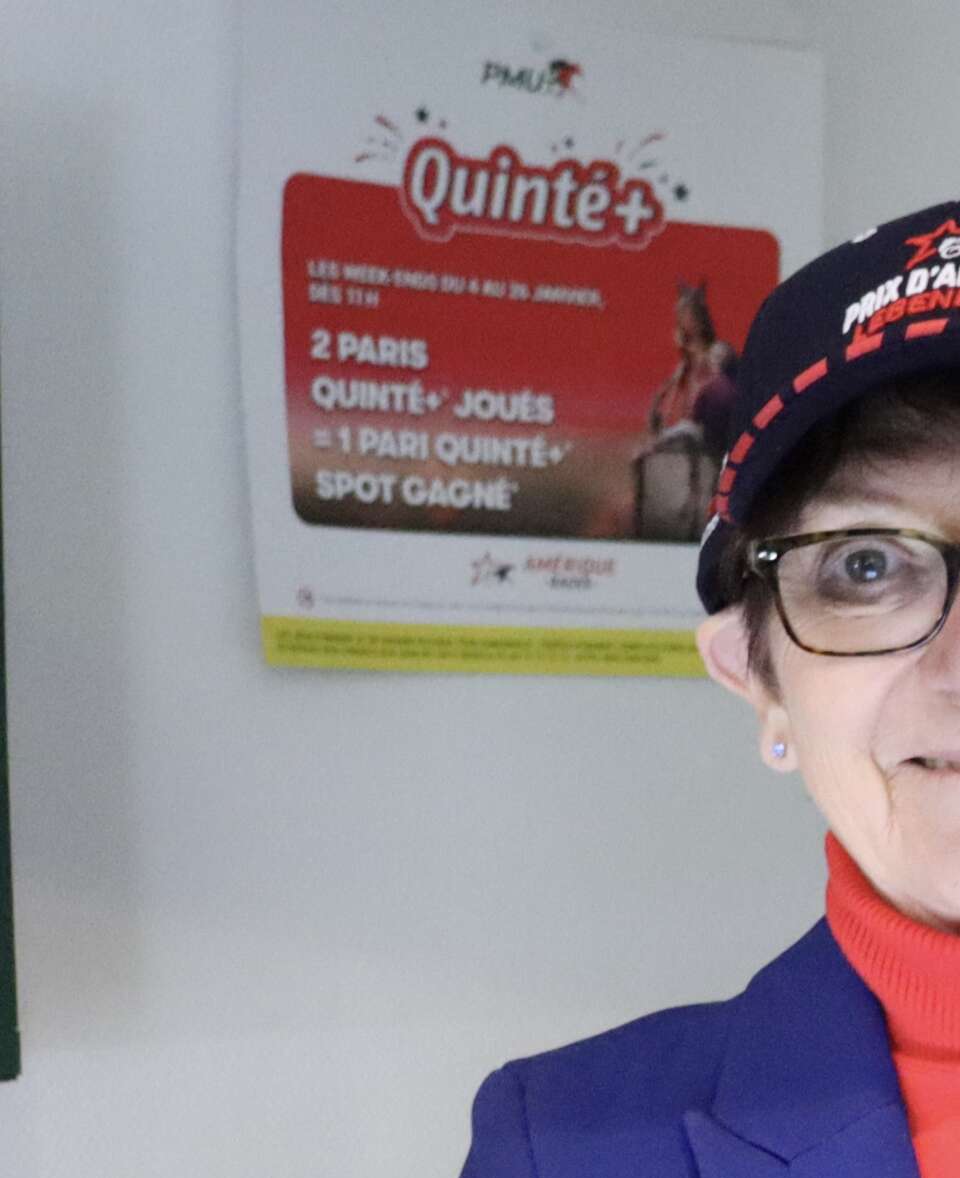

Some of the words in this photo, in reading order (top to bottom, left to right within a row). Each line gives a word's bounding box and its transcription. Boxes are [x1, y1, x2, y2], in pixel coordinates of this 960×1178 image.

[411, 149, 652, 234] Quinté+
[842, 275, 904, 335] PRIX
[311, 329, 330, 360] 2
[338, 332, 429, 369] PARIS
[453, 388, 556, 424] JOUÉS
[338, 427, 351, 451] 1
[359, 428, 429, 460] PARI
[316, 469, 398, 504] SPOT
